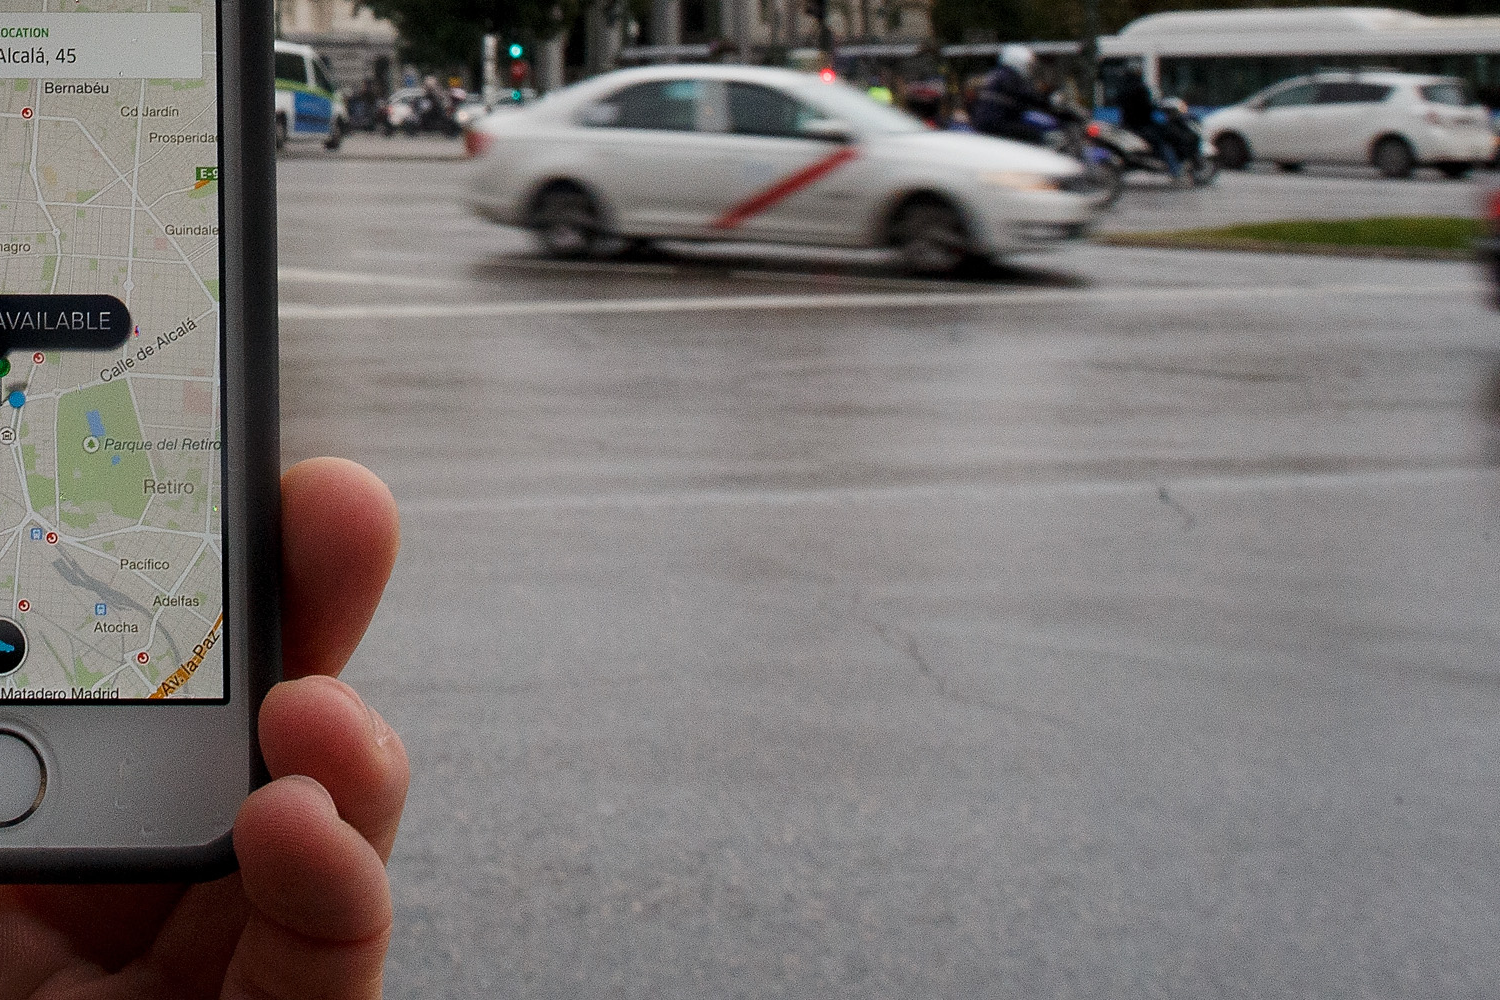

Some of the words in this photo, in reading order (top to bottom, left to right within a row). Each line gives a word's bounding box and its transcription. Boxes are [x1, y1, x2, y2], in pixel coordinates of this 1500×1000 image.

[55, 48, 77, 64] 45
[44, 82, 109, 94] Bernabéu
[120, 106, 138, 117] Cd
[142, 106, 179, 117] Jardín
[100, 357, 135, 382] Calle
[136, 345, 155, 361] de
[156, 317, 198, 350] Alcalá
[104, 438, 152, 452] Parque
[156, 438, 177, 450] del
[181, 438, 221, 450] Retiro
[143, 479, 194, 494] Retiro
[120, 558, 170, 570] Pacífico
[153, 595, 199, 607] Adelfas
[94, 621, 138, 633] Atocha
[161, 676, 184, 696] Av.
[181, 660, 199, 675] la
[192, 630, 220, 659] Paz
[1, 687, 67, 699] Matadero
[71, 687, 119, 699] Madrid
